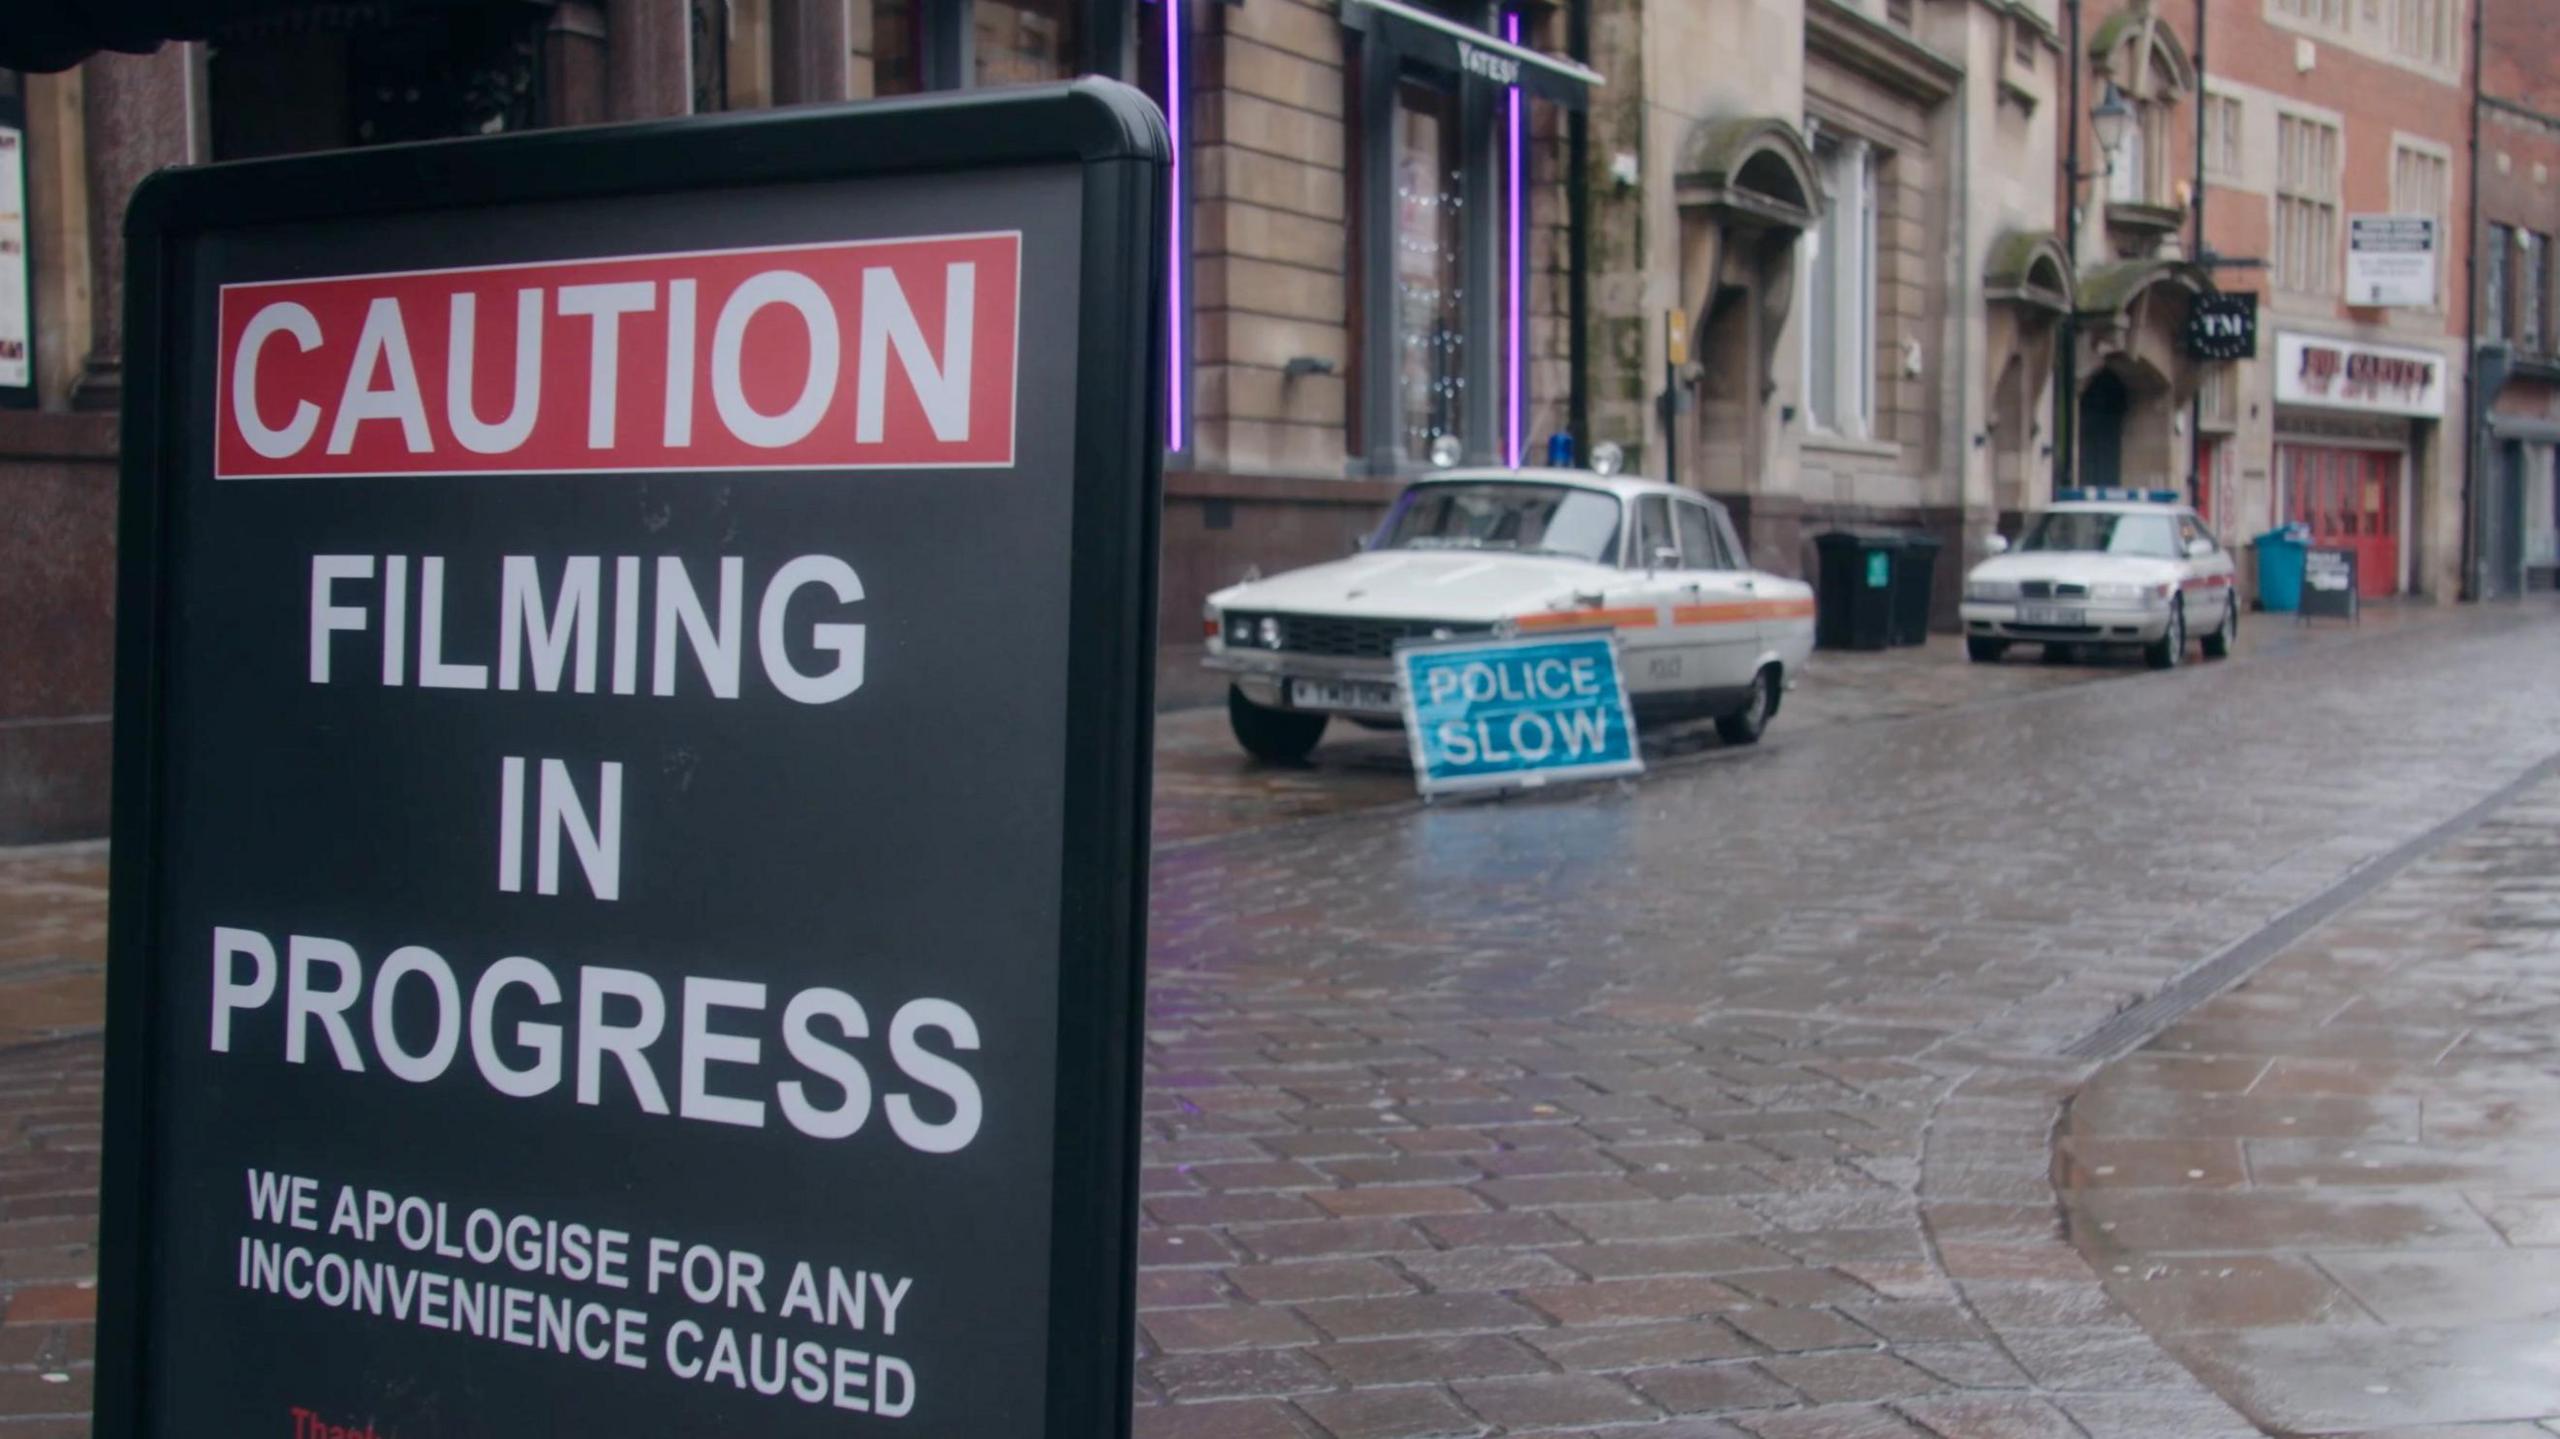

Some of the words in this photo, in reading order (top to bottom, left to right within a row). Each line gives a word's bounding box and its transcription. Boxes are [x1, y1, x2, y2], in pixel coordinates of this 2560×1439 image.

[233, 260, 978, 459] CAUTION
[310, 554, 867, 704] FILMING
[1428, 657, 1600, 704] POLICE
[1438, 706, 1606, 766] SLOW
[499, 756, 622, 901] IN
[211, 927, 982, 1153] PROGRESS
[239, 1237, 647, 1369] INCONVENIENCE
[666, 1320, 916, 1419] CAUSED
[247, 1169, 318, 1231] WE
[329, 1184, 629, 1289] APOLOGISE
[647, 1237, 766, 1313] FOR
[779, 1261, 913, 1336] ANY
